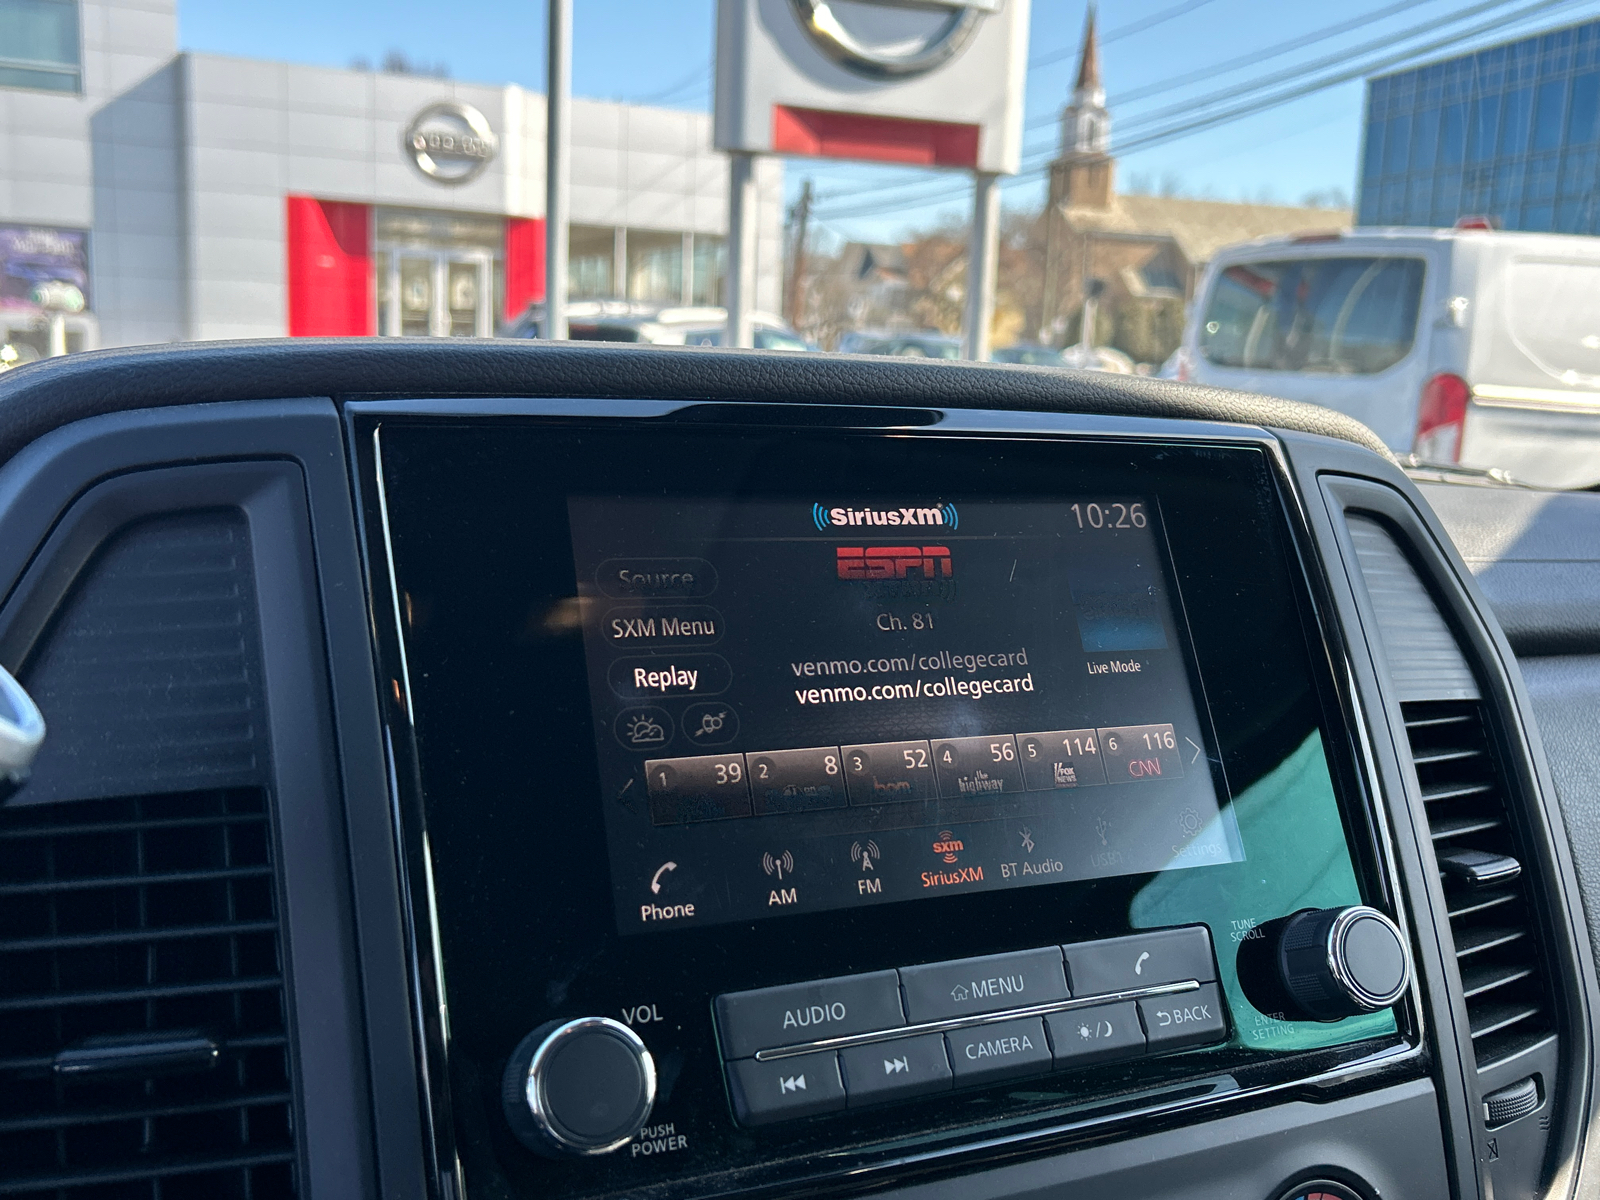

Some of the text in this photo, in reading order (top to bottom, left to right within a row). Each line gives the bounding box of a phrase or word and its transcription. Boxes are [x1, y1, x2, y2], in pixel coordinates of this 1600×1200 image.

[1070, 503, 1147, 530] 10:26
[836, 546, 953, 580] ESPN
[619, 569, 695, 589] Source
[611, 617, 715, 638] SXM Menu
[876, 612, 934, 631] Ch. 81
[791, 648, 1029, 677] venmo.com/collegecard
[1087, 659, 1142, 674] Live Mode
[634, 665, 698, 692] Replay
[795, 673, 1034, 705] venmo.com/collegecard
[1027, 737, 1096, 758] 5 114
[1108, 731, 1175, 751] 6 116
[853, 749, 929, 771] 3 52
[943, 743, 1014, 764] 4 56
[658, 763, 742, 787] 1 39
[758, 755, 838, 779] 2 8
[1060, 767, 1075, 776] FOX
[1128, 758, 1162, 778] CNN
[958, 776, 1004, 793] highway
[933, 840, 964, 854] sxm
[1171, 843, 1222, 858] Settings
[921, 866, 984, 888] SiriusXM
[1001, 858, 1064, 878] BT Audio
[858, 877, 882, 895] FM
[768, 887, 798, 906] AM
[641, 902, 695, 921] Phone
[1230, 917, 1257, 931] TUNE
[1230, 927, 1266, 943] SCROLL
[971, 974, 1025, 999] MENU
[621, 1004, 664, 1026] VOL
[782, 1002, 846, 1029] AUDIO
[1173, 1004, 1212, 1024] BACK
[1254, 1011, 1286, 1027] ENTER
[1252, 1023, 1295, 1041] SETTING
[965, 1034, 1034, 1060] CAMERA
[640, 1123, 675, 1140] PUSH
[631, 1133, 688, 1157] POWER
